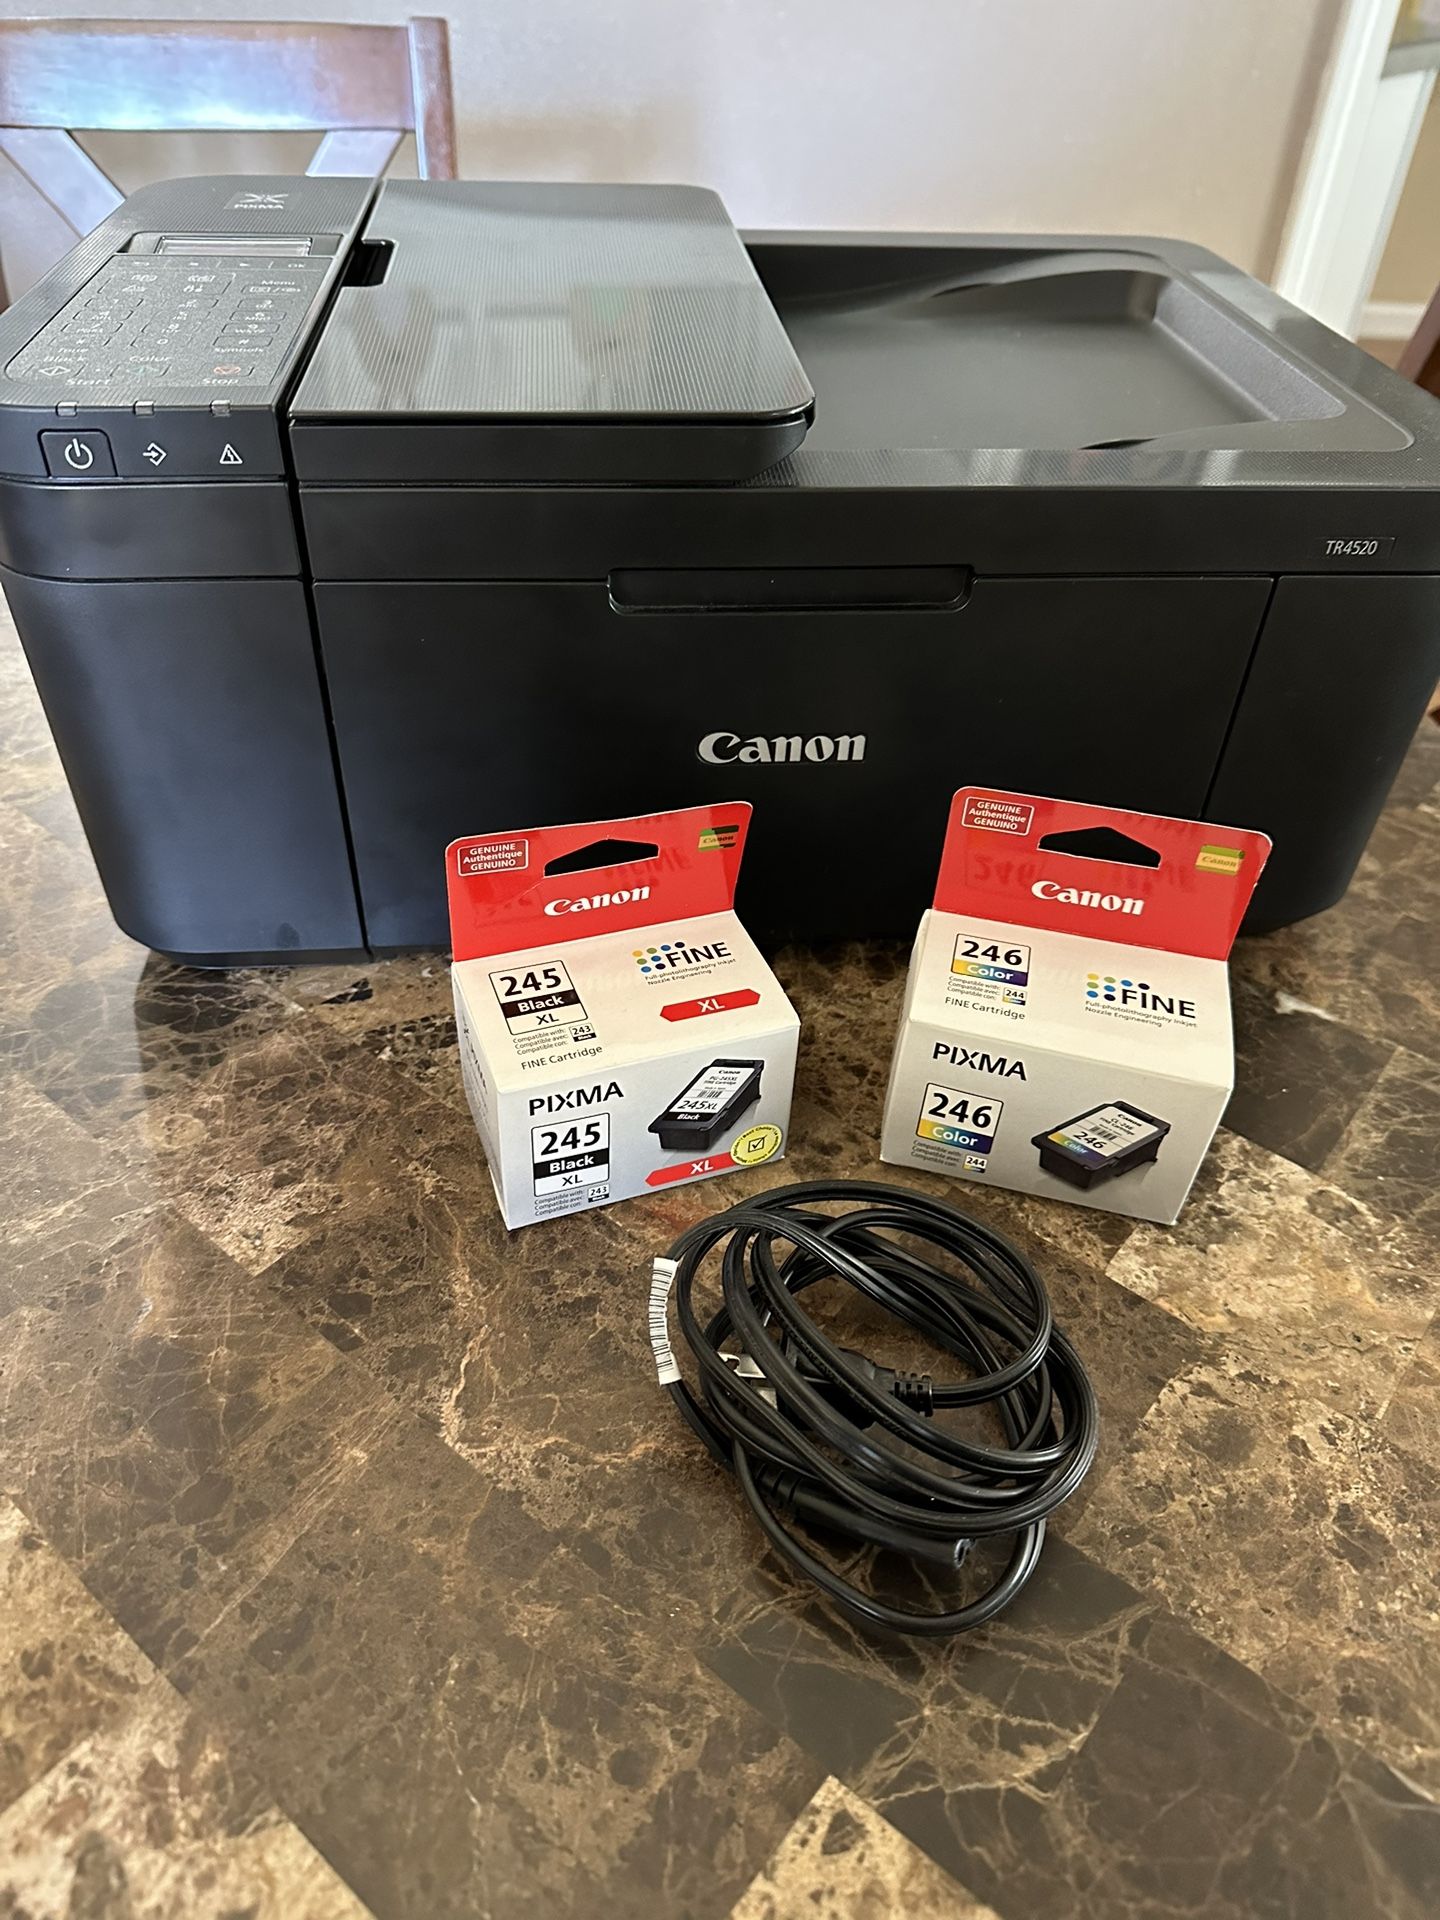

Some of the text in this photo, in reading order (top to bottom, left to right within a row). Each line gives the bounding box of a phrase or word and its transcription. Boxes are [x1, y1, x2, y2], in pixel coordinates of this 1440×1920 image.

[66, 378, 112, 386] Start
[202, 378, 240, 386] Stop
[1326, 540, 1378, 555] TR4520
[698, 732, 866, 764] Canon
[968, 808, 1027, 823] Authentique
[976, 801, 1022, 815] GENUINE
[973, 817, 1018, 831] GENUINO
[469, 842, 517, 856] GENUINE
[463, 850, 523, 865] Authentique
[470, 859, 516, 871] GENUINO
[1202, 855, 1238, 867] Canon
[544, 886, 651, 916] Canon
[1031, 880, 1145, 916] Canon
[665, 941, 732, 968] FINE
[960, 940, 1023, 966] 246
[717, 958, 737, 967] Inkjet
[647, 968, 713, 986] Nozzle Engineering
[966, 964, 1014, 980] Color
[499, 967, 562, 997] 245
[947, 981, 984, 993] Compatible
[948, 975, 984, 987] Compatible
[947, 985, 983, 997] Compatible
[1005, 989, 1025, 999] 244
[517, 995, 565, 1013] Black
[697, 998, 726, 1013] XL
[944, 996, 1026, 1020] FINE Cartridge
[1121, 988, 1197, 1019] FINE
[535, 1013, 560, 1026] XL
[1085, 1000, 1198, 1028] Full-photolithography Inkjet
[1085, 1006, 1163, 1028] Nozzle Engineering
[512, 1031, 550, 1044] Compatible
[571, 1025, 592, 1036] 243
[514, 1038, 552, 1050] Compatible
[516, 1043, 554, 1056] Compatible
[520, 1046, 603, 1070] FINE Cartridge
[932, 1041, 1027, 1082] PIXMA
[529, 1081, 625, 1116] PIXMA
[677, 1100, 718, 1110] 245XL
[677, 1112, 700, 1120] Black
[928, 1092, 993, 1129] 246
[1117, 1113, 1142, 1127] Canon
[540, 1121, 601, 1156] 245
[932, 1126, 979, 1147] Color
[1072, 1130, 1107, 1149] 246
[1063, 1139, 1089, 1154] Color
[549, 1154, 595, 1174] Black
[690, 1159, 714, 1175] XL
[966, 1156, 985, 1167] 244
[561, 1174, 583, 1187] XL
[534, 1193, 569, 1205] Compatible
[590, 1186, 607, 1197] 243
[534, 1199, 570, 1211] Compatible
[534, 1204, 567, 1217] Compatible
